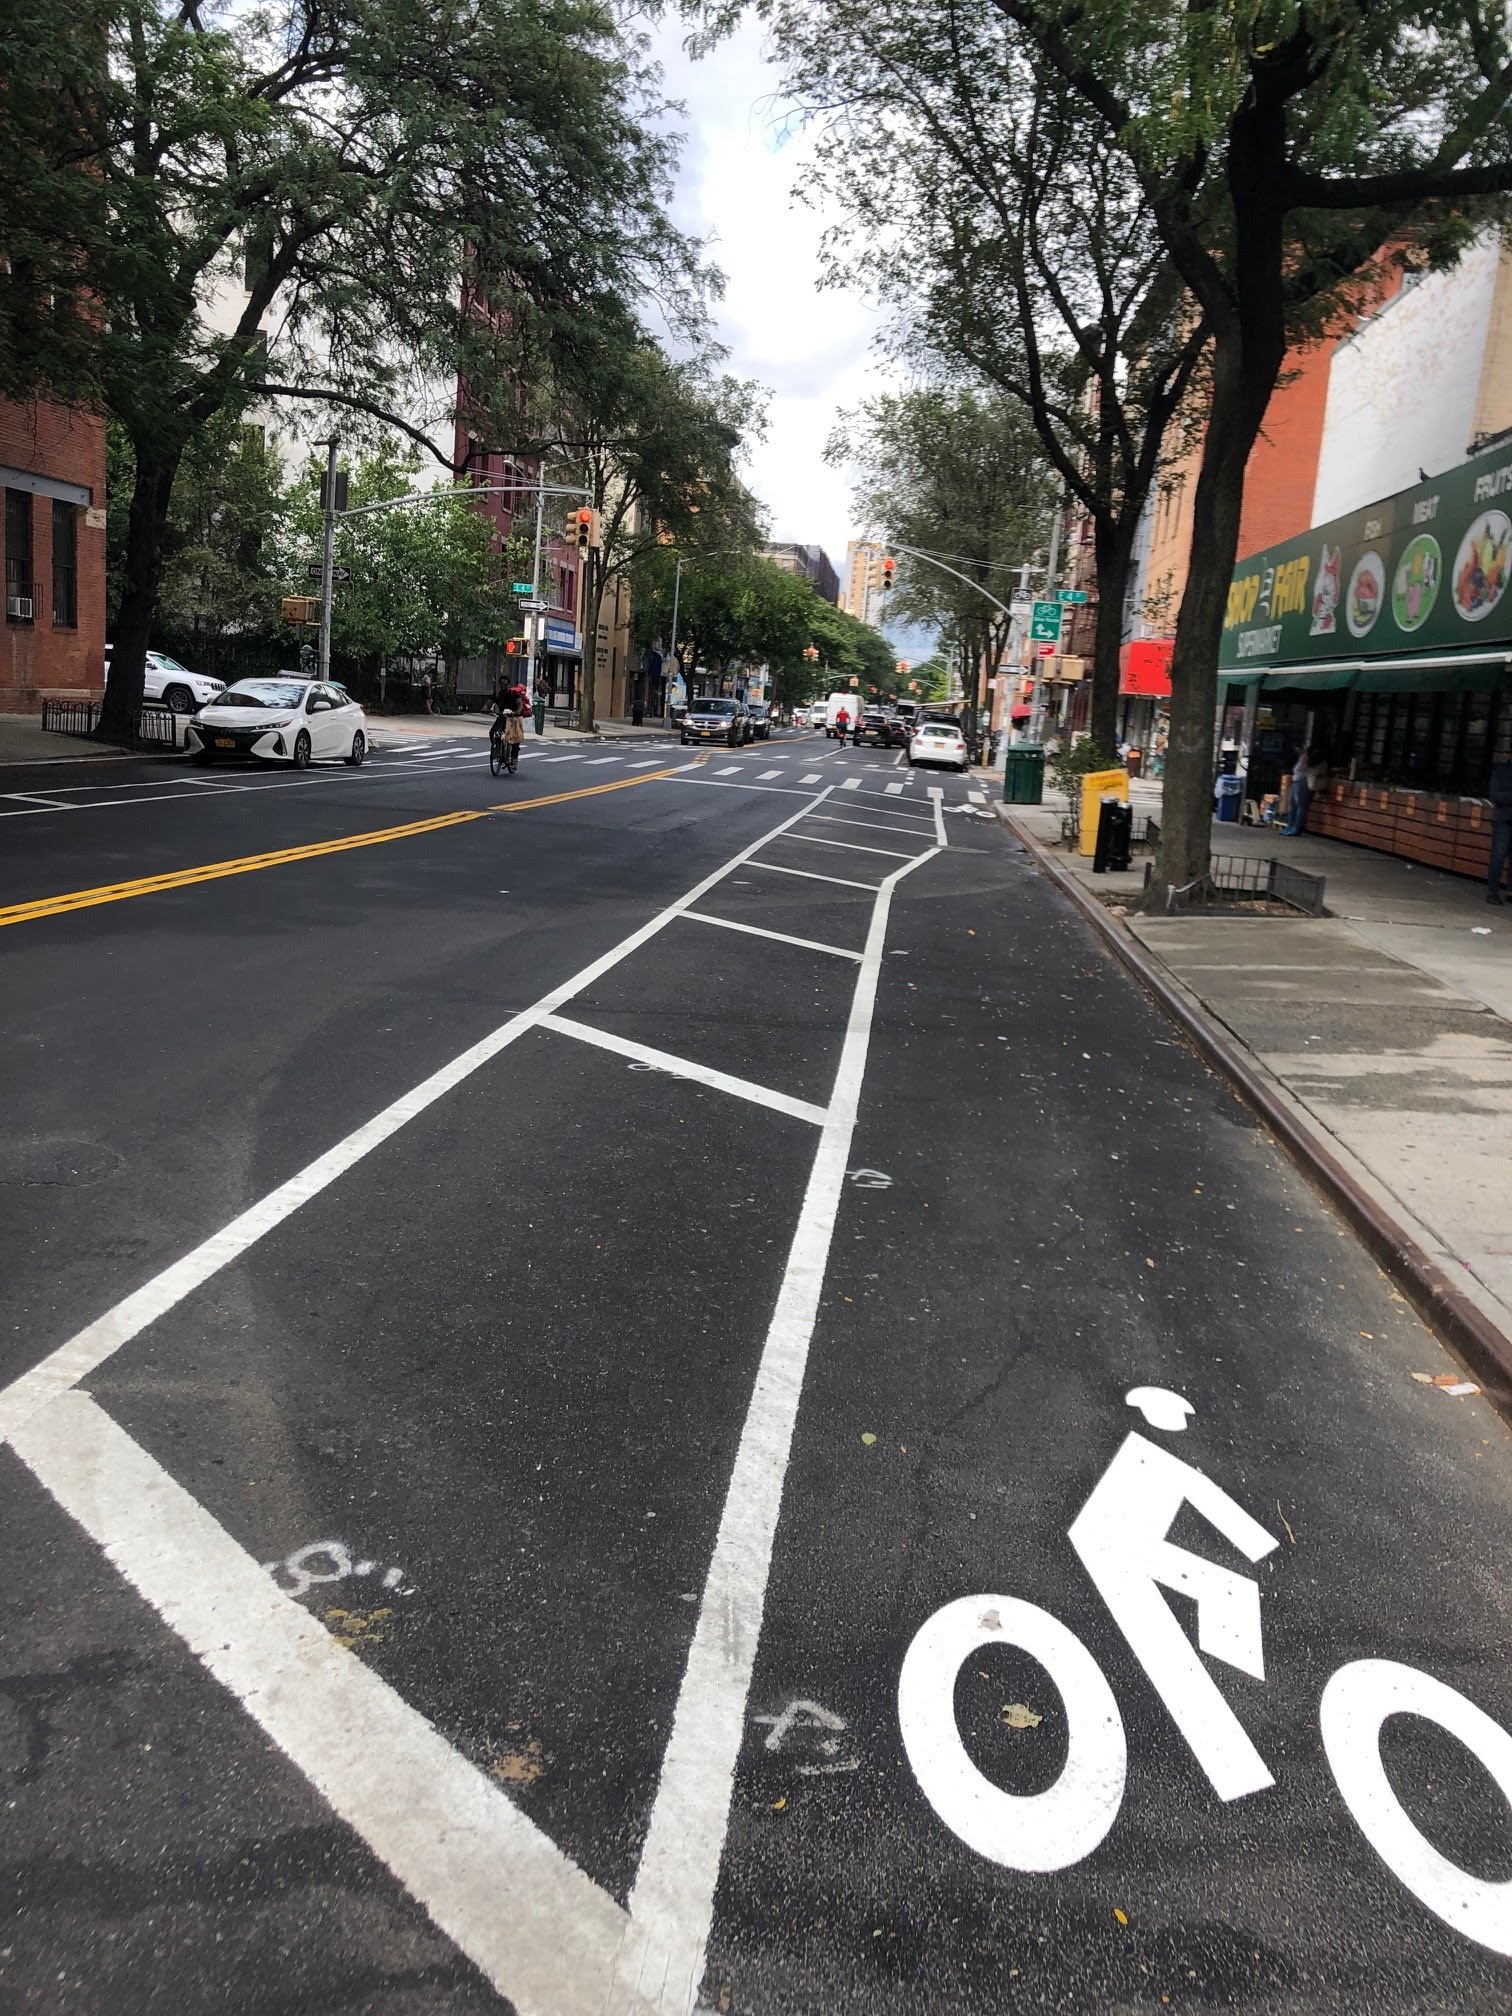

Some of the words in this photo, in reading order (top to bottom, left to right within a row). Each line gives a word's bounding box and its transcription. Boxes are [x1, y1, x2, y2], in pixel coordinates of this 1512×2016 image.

[1412, 495, 1440, 525] MEAT
[1058, 591, 1065, 601] E
[1067, 592, 1074, 601] 4
[1224, 575, 1260, 629] SHOP
[1270, 555, 1310, 621] FAIR
